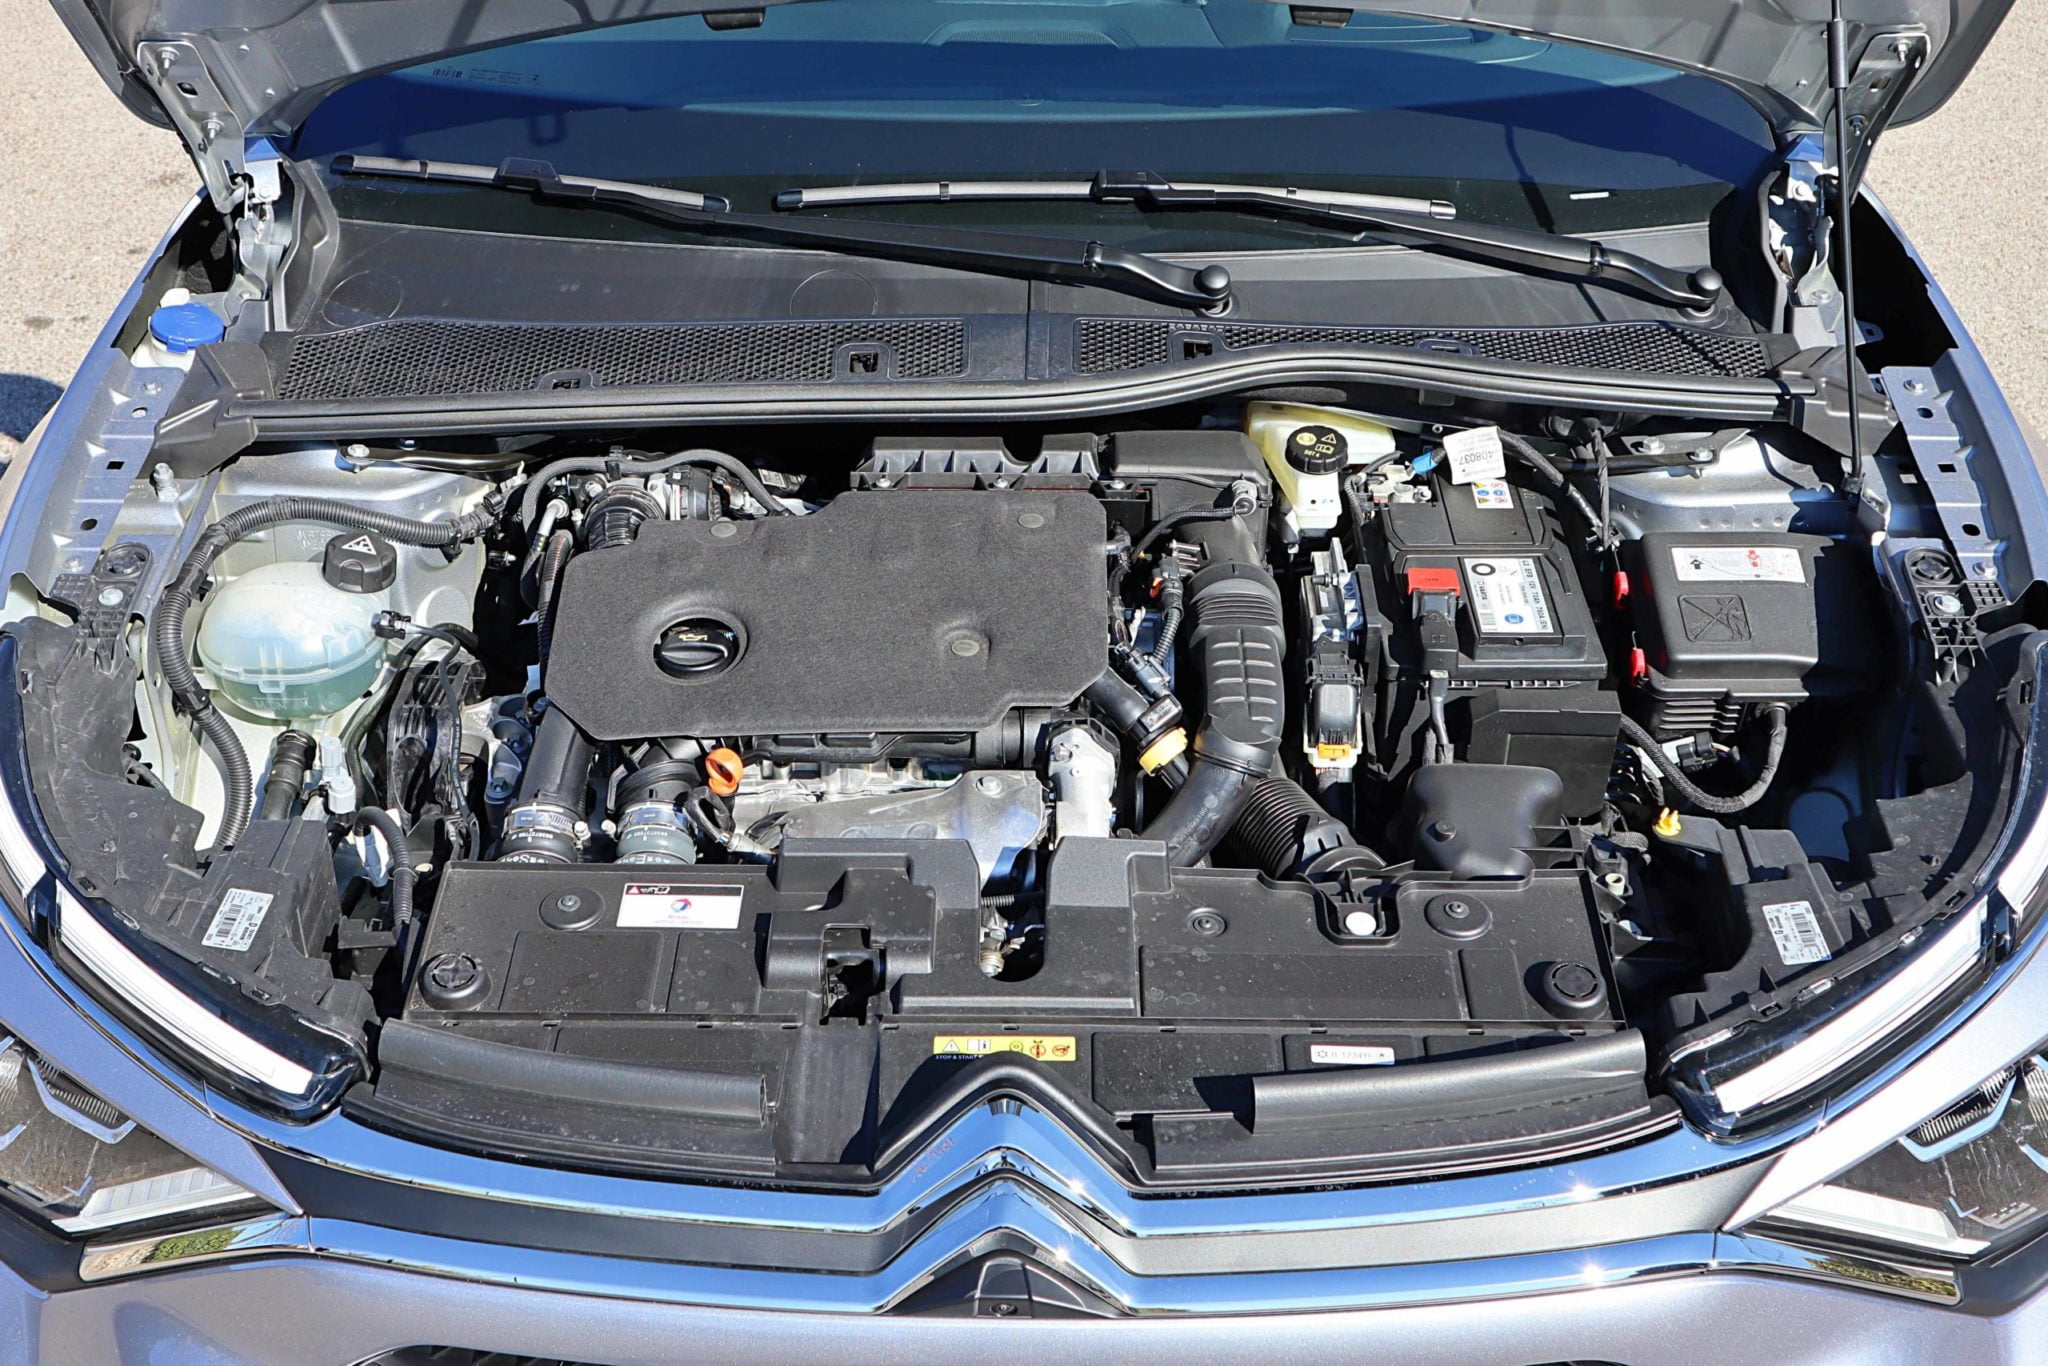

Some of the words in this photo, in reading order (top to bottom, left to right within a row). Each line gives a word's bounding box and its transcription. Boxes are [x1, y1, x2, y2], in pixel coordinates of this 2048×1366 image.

[1303, 449, 1315, 457] DOT
[1459, 450, 1494, 465] 408037
[1529, 580, 1537, 590] 12V
